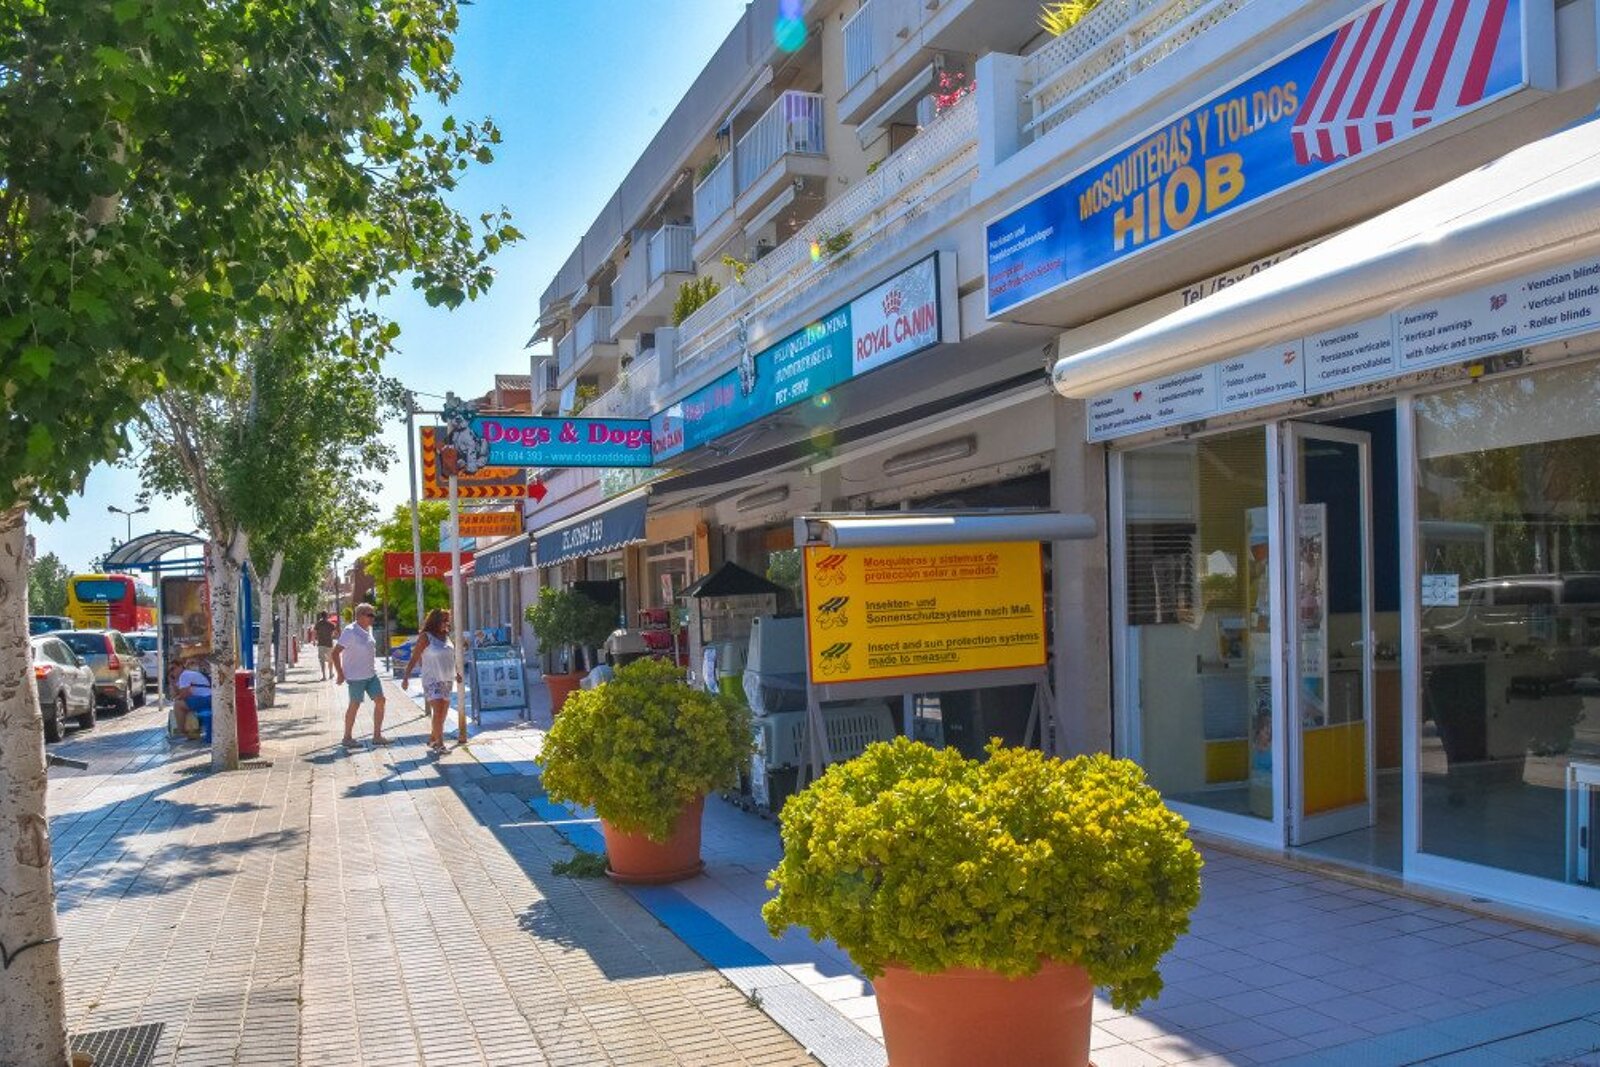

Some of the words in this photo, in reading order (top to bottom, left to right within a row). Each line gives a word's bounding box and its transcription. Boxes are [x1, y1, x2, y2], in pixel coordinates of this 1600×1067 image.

[1079, 117, 1192, 222] MOSQUITERAS
[1196, 112, 1210, 155] Y
[1214, 80, 1299, 147] TOLDOS
[1113, 152, 1246, 252] HIOB
[1527, 273, 1571, 291] Venetian
[1573, 263, 1600, 280] blind
[1528, 291, 1566, 311] Vertical
[1568, 285, 1599, 301] blinds
[1404, 310, 1439, 326] Awnings
[1529, 316, 1558, 330] Roller
[1560, 307, 1592, 322] blinds
[857, 325, 892, 361] ROYAL
[894, 303, 935, 344] CANIN
[1319, 331, 1360, 348] Venecianas
[1405, 327, 1436, 343] Vertical
[1437, 319, 1472, 334] awnings
[1405, 347, 1425, 360] with
[1425, 343, 1449, 356] fabric
[1450, 337, 1466, 349] and
[1468, 330, 1499, 346] transp.
[1501, 324, 1517, 337] foil
[1320, 350, 1354, 364] Persianas
[1356, 339, 1391, 355] verticales
[1321, 366, 1351, 380] Cortinas
[1351, 356, 1392, 373] enrollables
[481, 420, 552, 448] Dogs
[559, 420, 581, 444] &
[588, 422, 653, 450] Dogs
[551, 450, 651, 465] www.dogsanddogs.co
[864, 556, 928, 569] Mosquiteras
[930, 557, 937, 568] y
[939, 553, 985, 565] sistemas
[986, 552, 999, 562] de
[864, 568, 921, 583] protección
[923, 566, 949, 578] solar
[951, 568, 958, 577] a
[959, 564, 998, 576] medida.
[865, 598, 914, 610] Insekten-
[917, 597, 937, 608] und
[866, 606, 983, 624] Sonnenschutzsysteme
[984, 605, 1009, 617] nach
[868, 641, 900, 653] Insect
[902, 639, 922, 650] and
[924, 639, 943, 650] sun
[946, 634, 997, 649] protection
[999, 632, 1040, 647] systems
[868, 653, 897, 665] made
[900, 653, 911, 664] to
[913, 651, 961, 663] measure.
